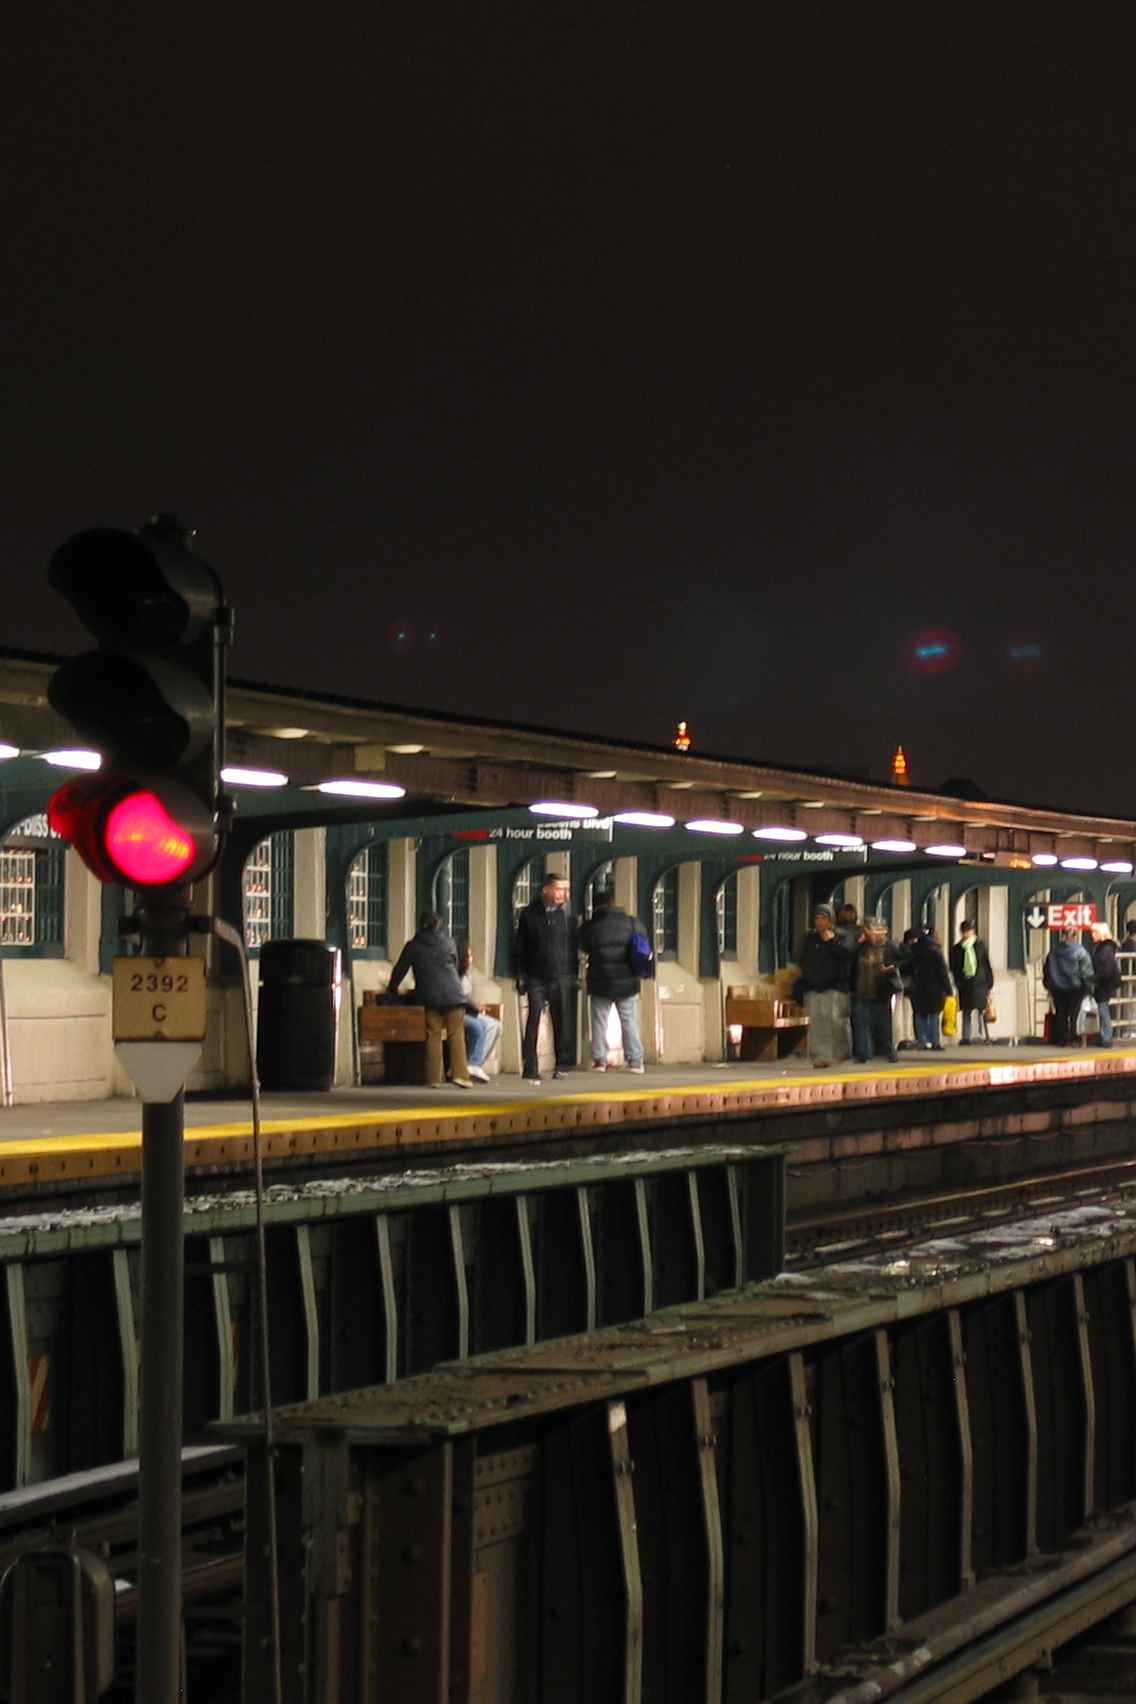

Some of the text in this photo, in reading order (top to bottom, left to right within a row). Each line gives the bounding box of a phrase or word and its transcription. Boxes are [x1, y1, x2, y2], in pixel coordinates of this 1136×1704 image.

[488, 827, 573, 840] 24 hour booth
[1048, 904, 1092, 926] Exit
[131, 974, 189, 992] 2392
[152, 1004, 167, 1022] C
